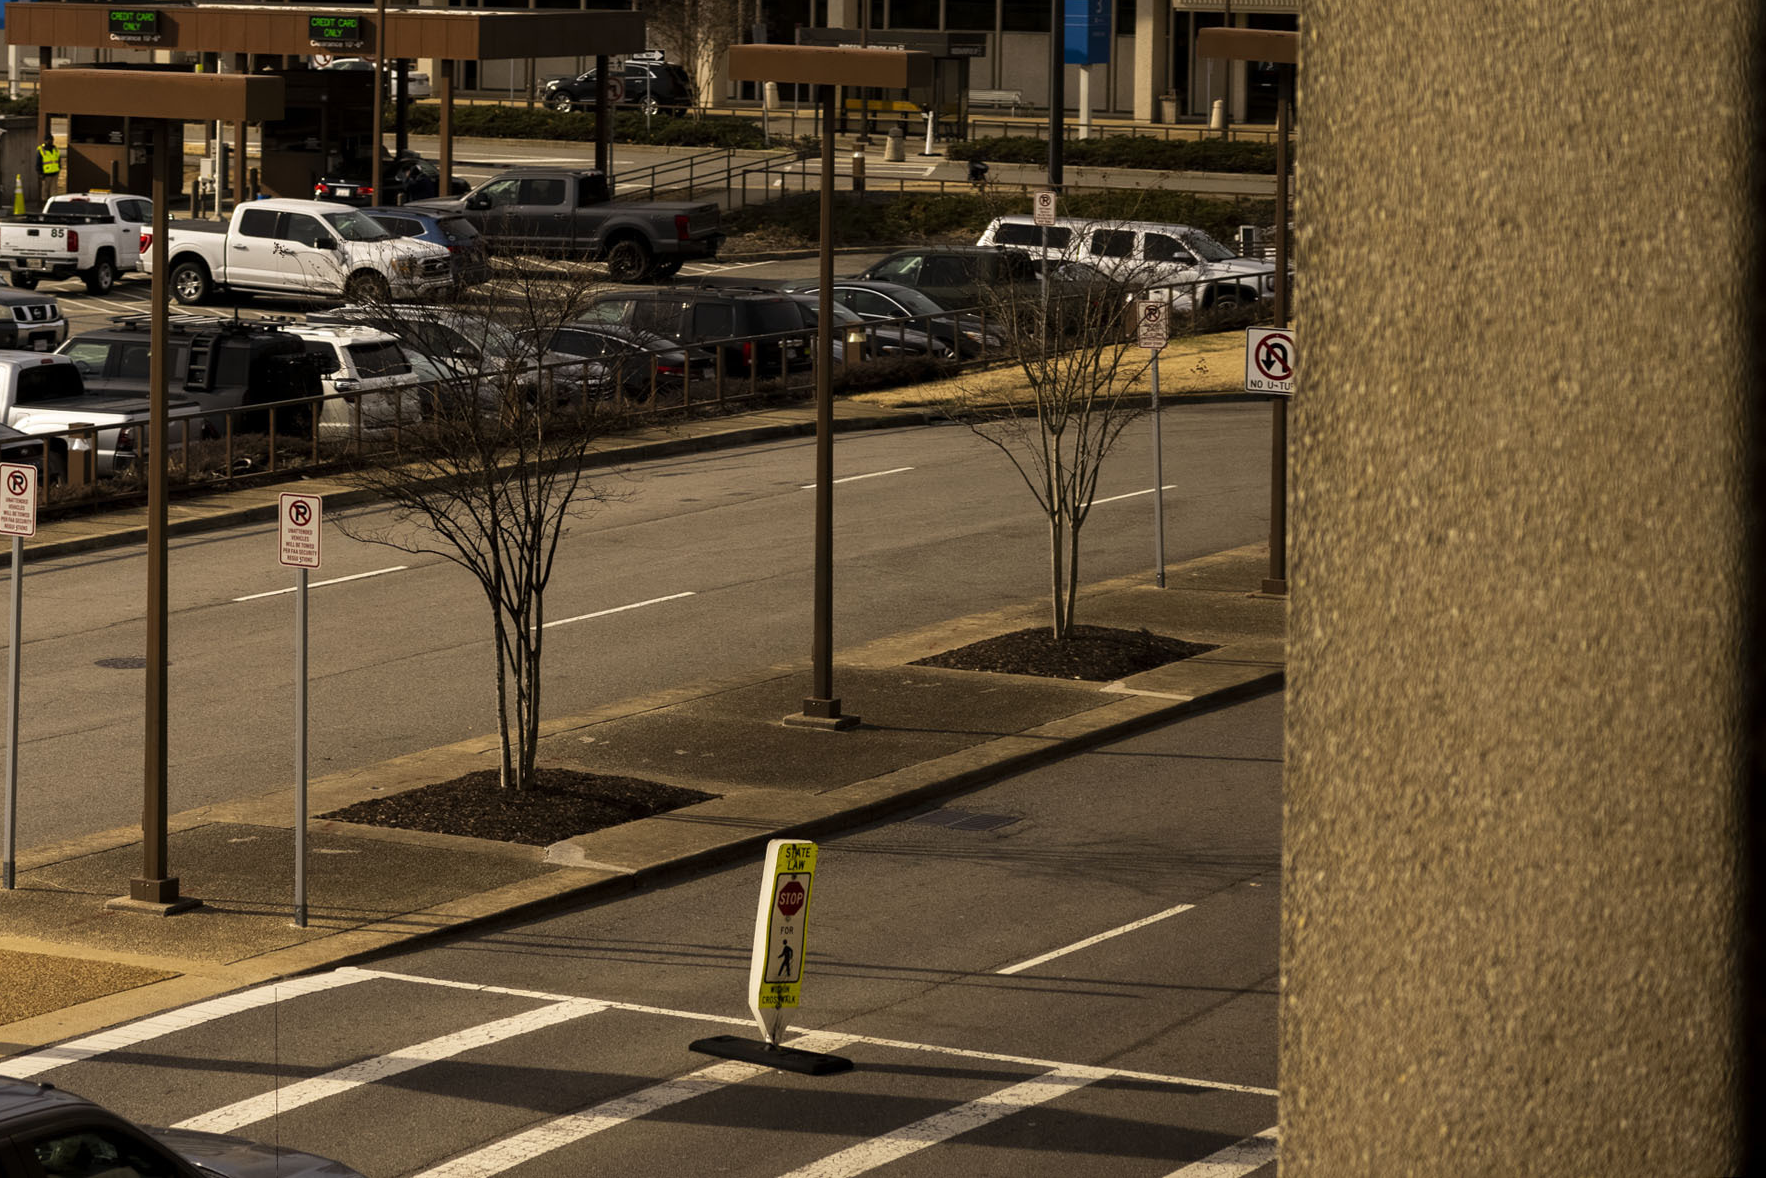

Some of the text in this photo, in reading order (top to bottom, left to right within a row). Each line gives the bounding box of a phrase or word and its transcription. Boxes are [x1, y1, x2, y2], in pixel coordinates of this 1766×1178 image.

[110, 11, 155, 21] CREDIT CARD
[122, 22, 142, 30] ONLY
[311, 17, 358, 28] CREDIT CARD
[323, 28, 343, 38] ONLY
[51, 228, 65, 238] 85
[1250, 380, 1264, 389] NO
[785, 847, 811, 858] STATE
[787, 860, 805, 871] LAW
[779, 892, 804, 906] STOP
[780, 926, 794, 935] FOR
